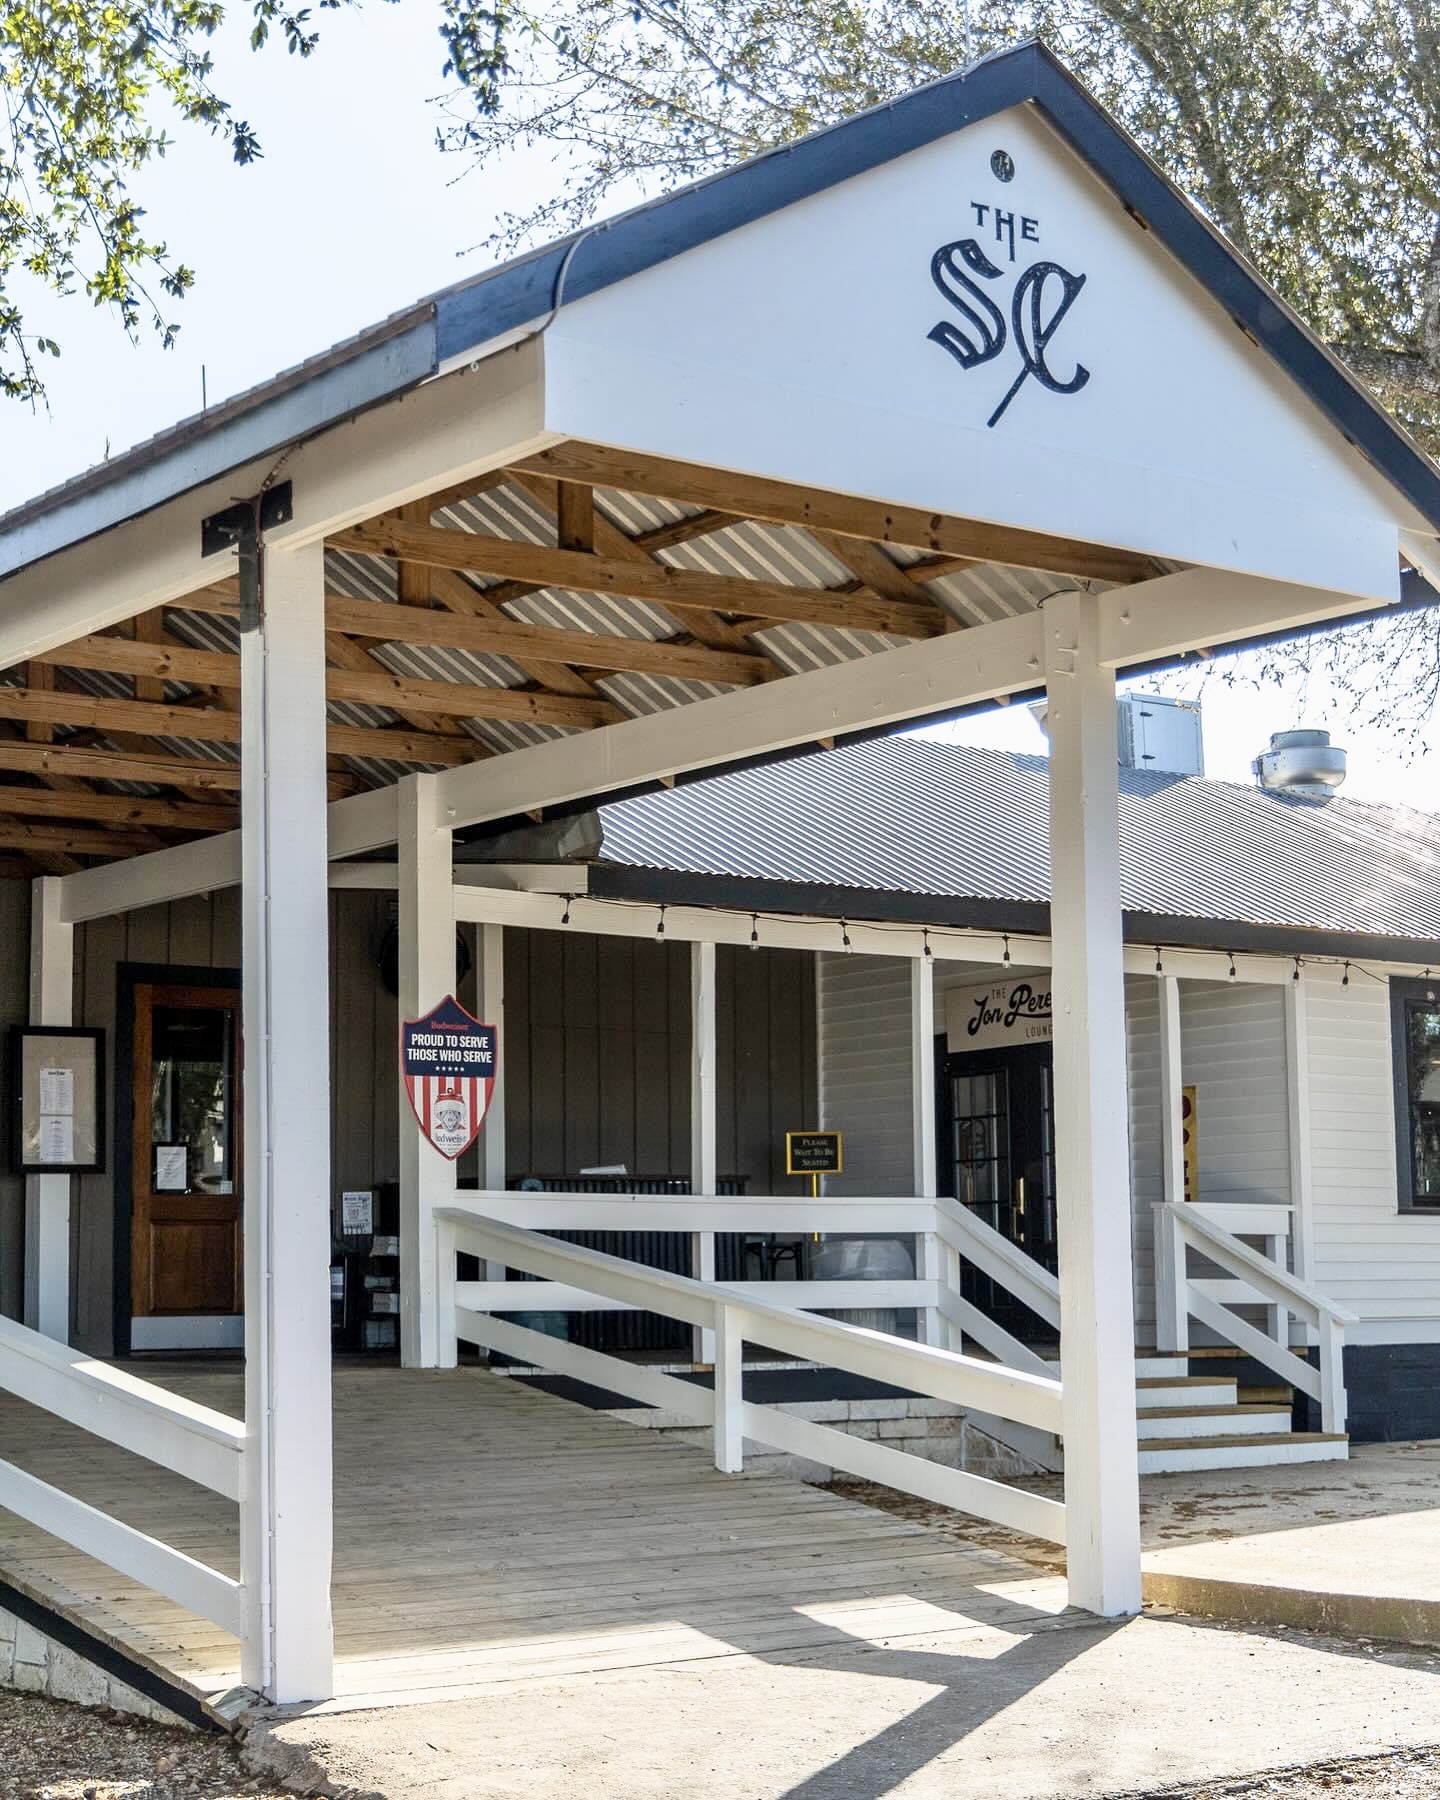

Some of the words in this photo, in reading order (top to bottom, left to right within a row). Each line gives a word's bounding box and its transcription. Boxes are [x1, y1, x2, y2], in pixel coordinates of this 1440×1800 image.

[970, 200, 1040, 262] THE
[991, 987, 1007, 1001] THE
[968, 995, 1003, 1036] Jon
[411, 1033, 444, 1047] PROUD
[445, 1034, 458, 1048] TO
[459, 1035, 489, 1049] SERVE
[408, 1048, 438, 1061] THOSE
[439, 1049, 461, 1062] WHO
[463, 1050, 492, 1064] SERVE
